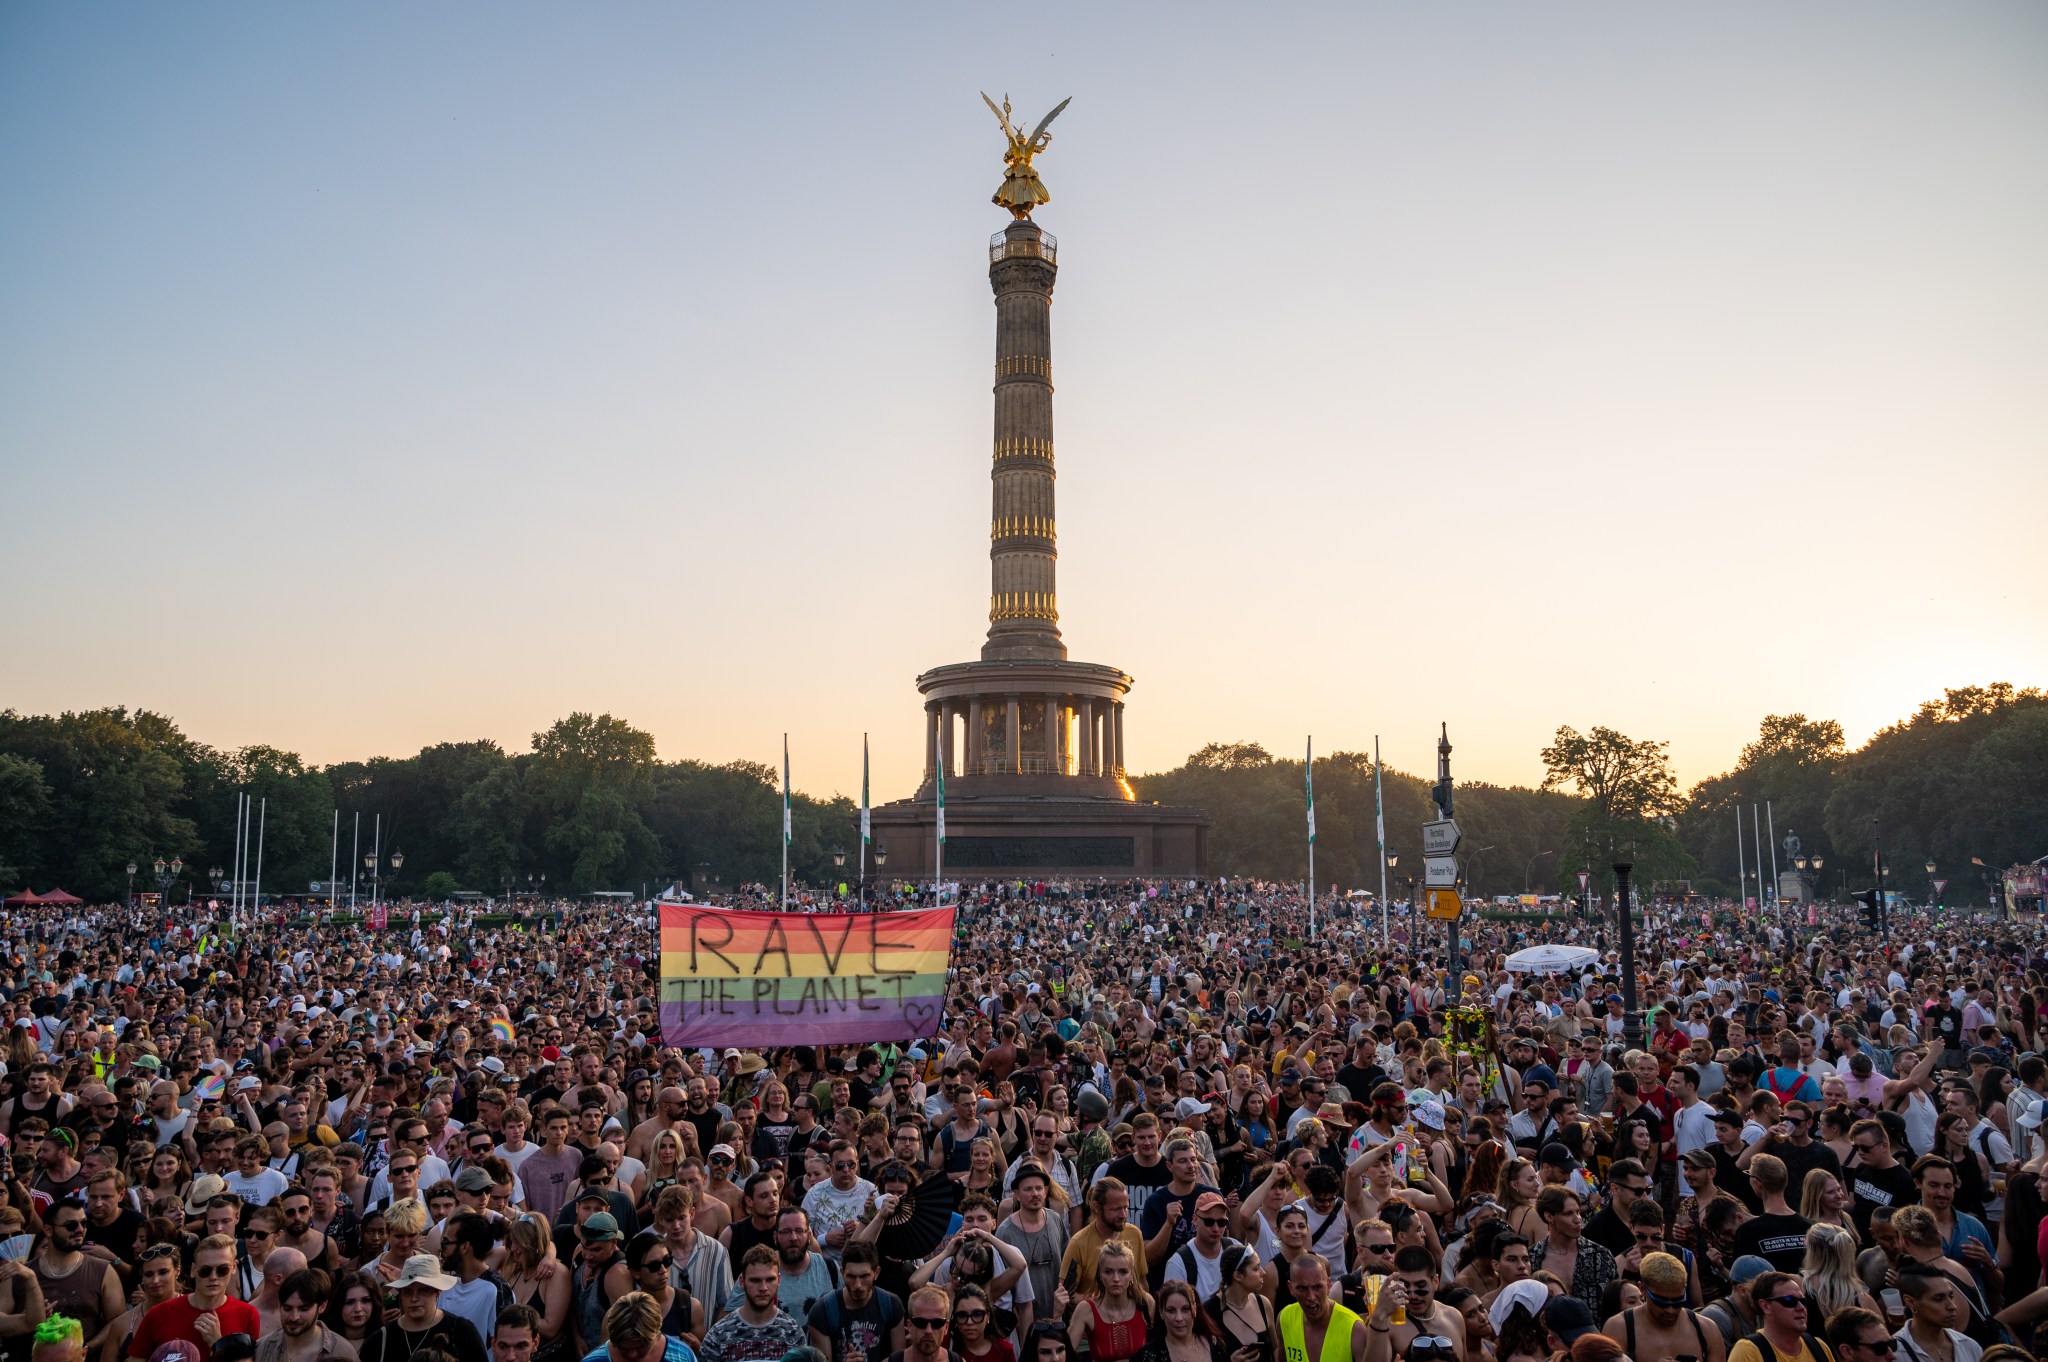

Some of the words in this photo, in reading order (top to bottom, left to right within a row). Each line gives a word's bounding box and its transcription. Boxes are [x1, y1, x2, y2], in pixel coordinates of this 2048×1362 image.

[690, 912, 919, 977] RAVE
[668, 978, 740, 1023] THE
[753, 974, 913, 1015] PLANET
[1287, 1346, 1303, 1361] 173
